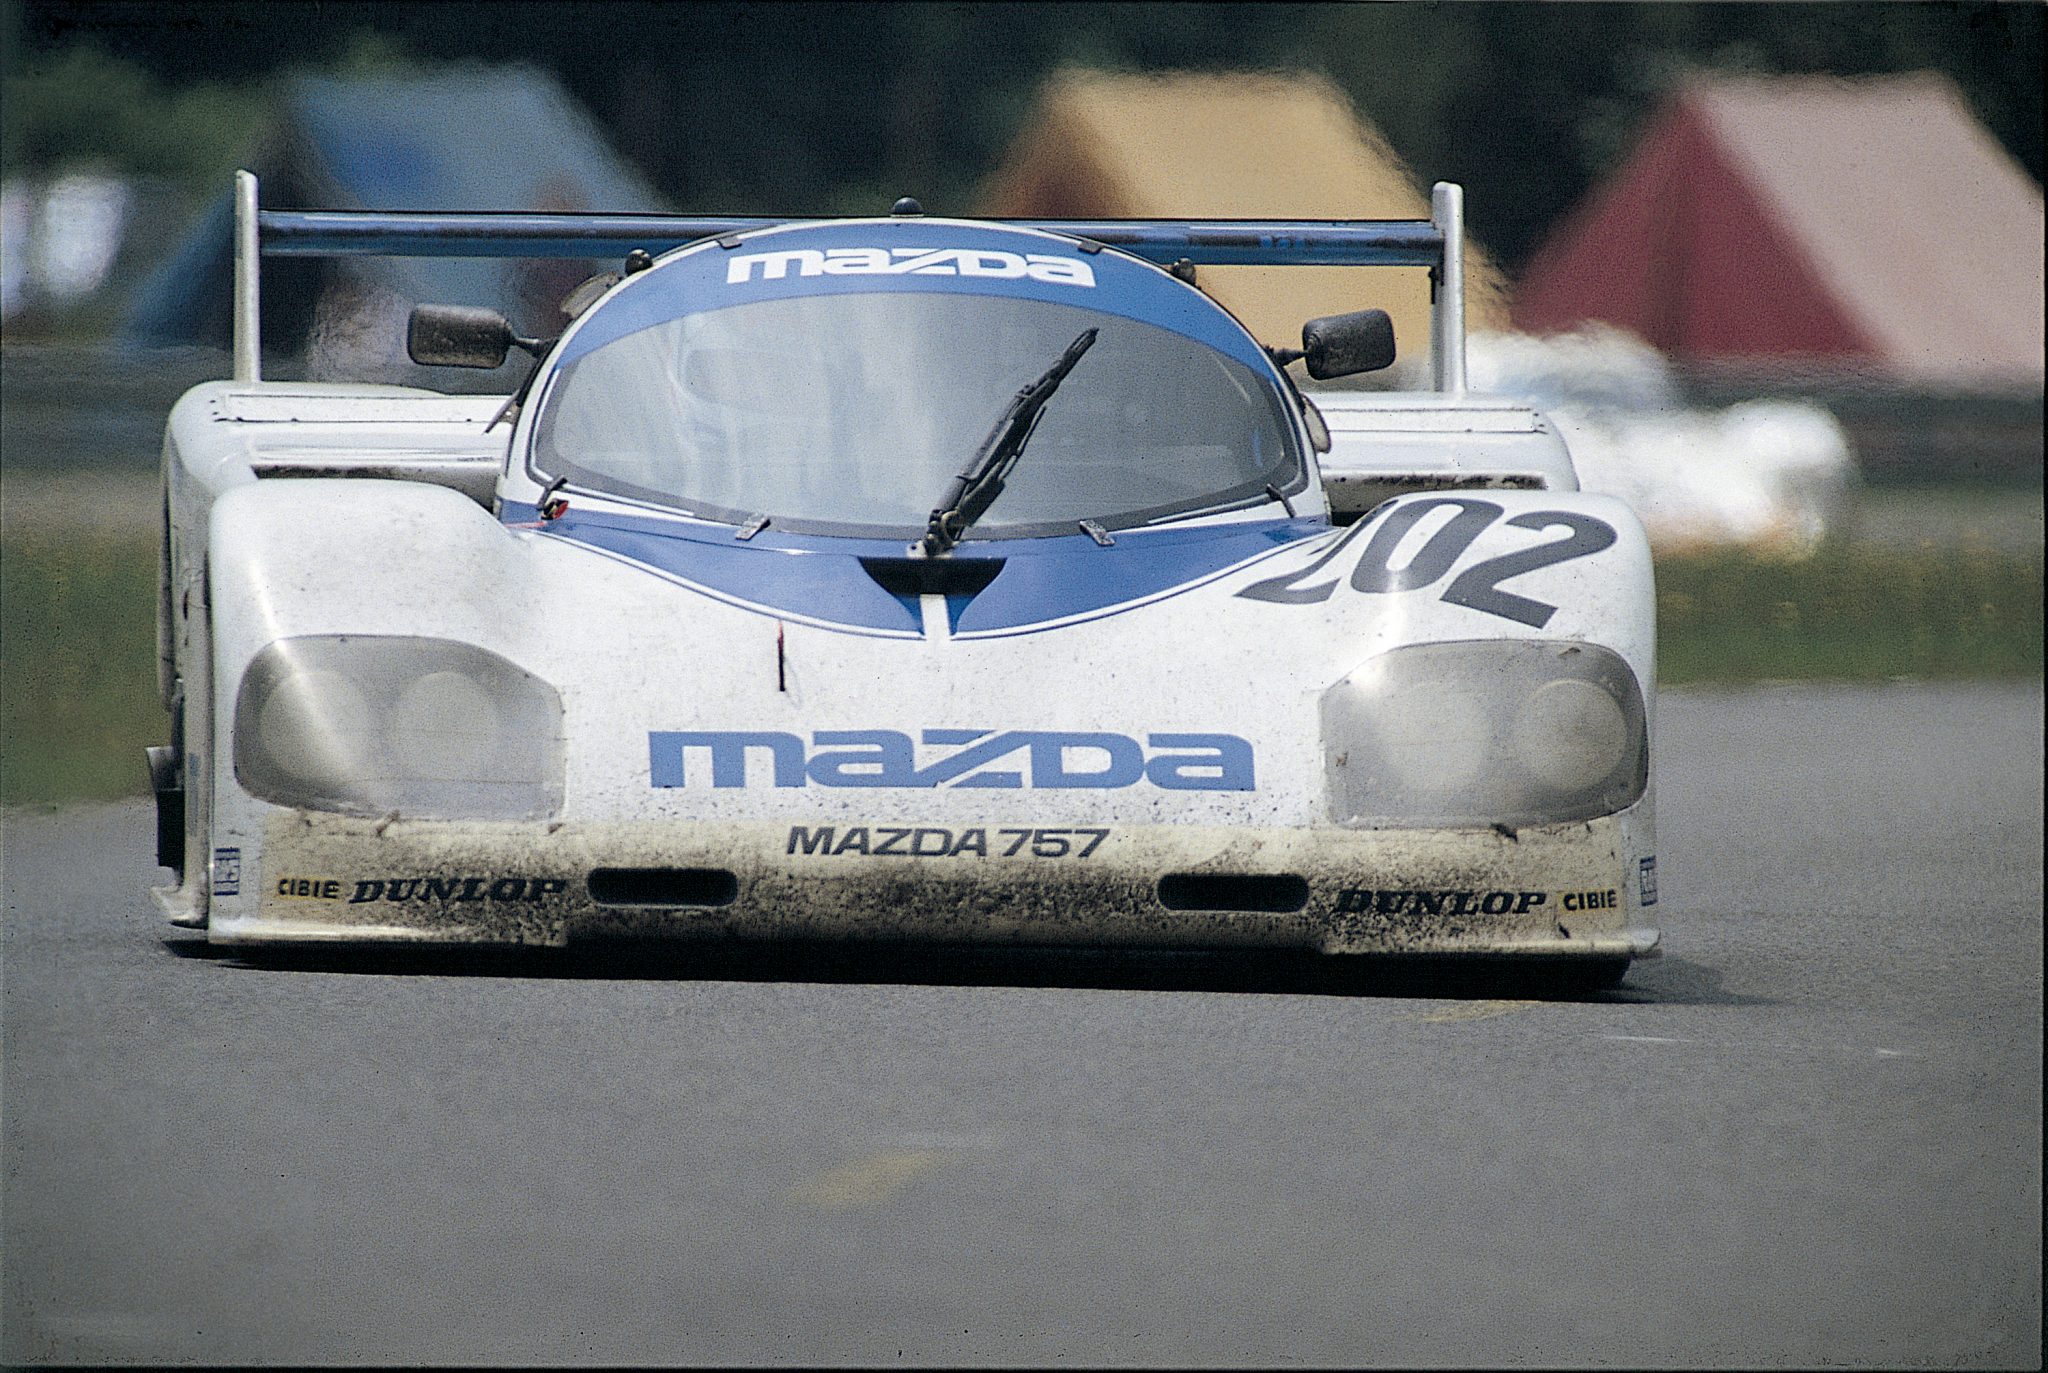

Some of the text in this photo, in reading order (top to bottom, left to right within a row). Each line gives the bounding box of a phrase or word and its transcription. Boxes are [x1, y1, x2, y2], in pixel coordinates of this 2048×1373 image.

[1232, 497, 1618, 630] 202
[786, 826, 1110, 858] MAZDA 757
[277, 877, 341, 900] CIBIE
[348, 877, 566, 905] DUNLOP
[1562, 889, 1618, 912] CIBIE
[1333, 889, 1548, 916] DUNLOP
